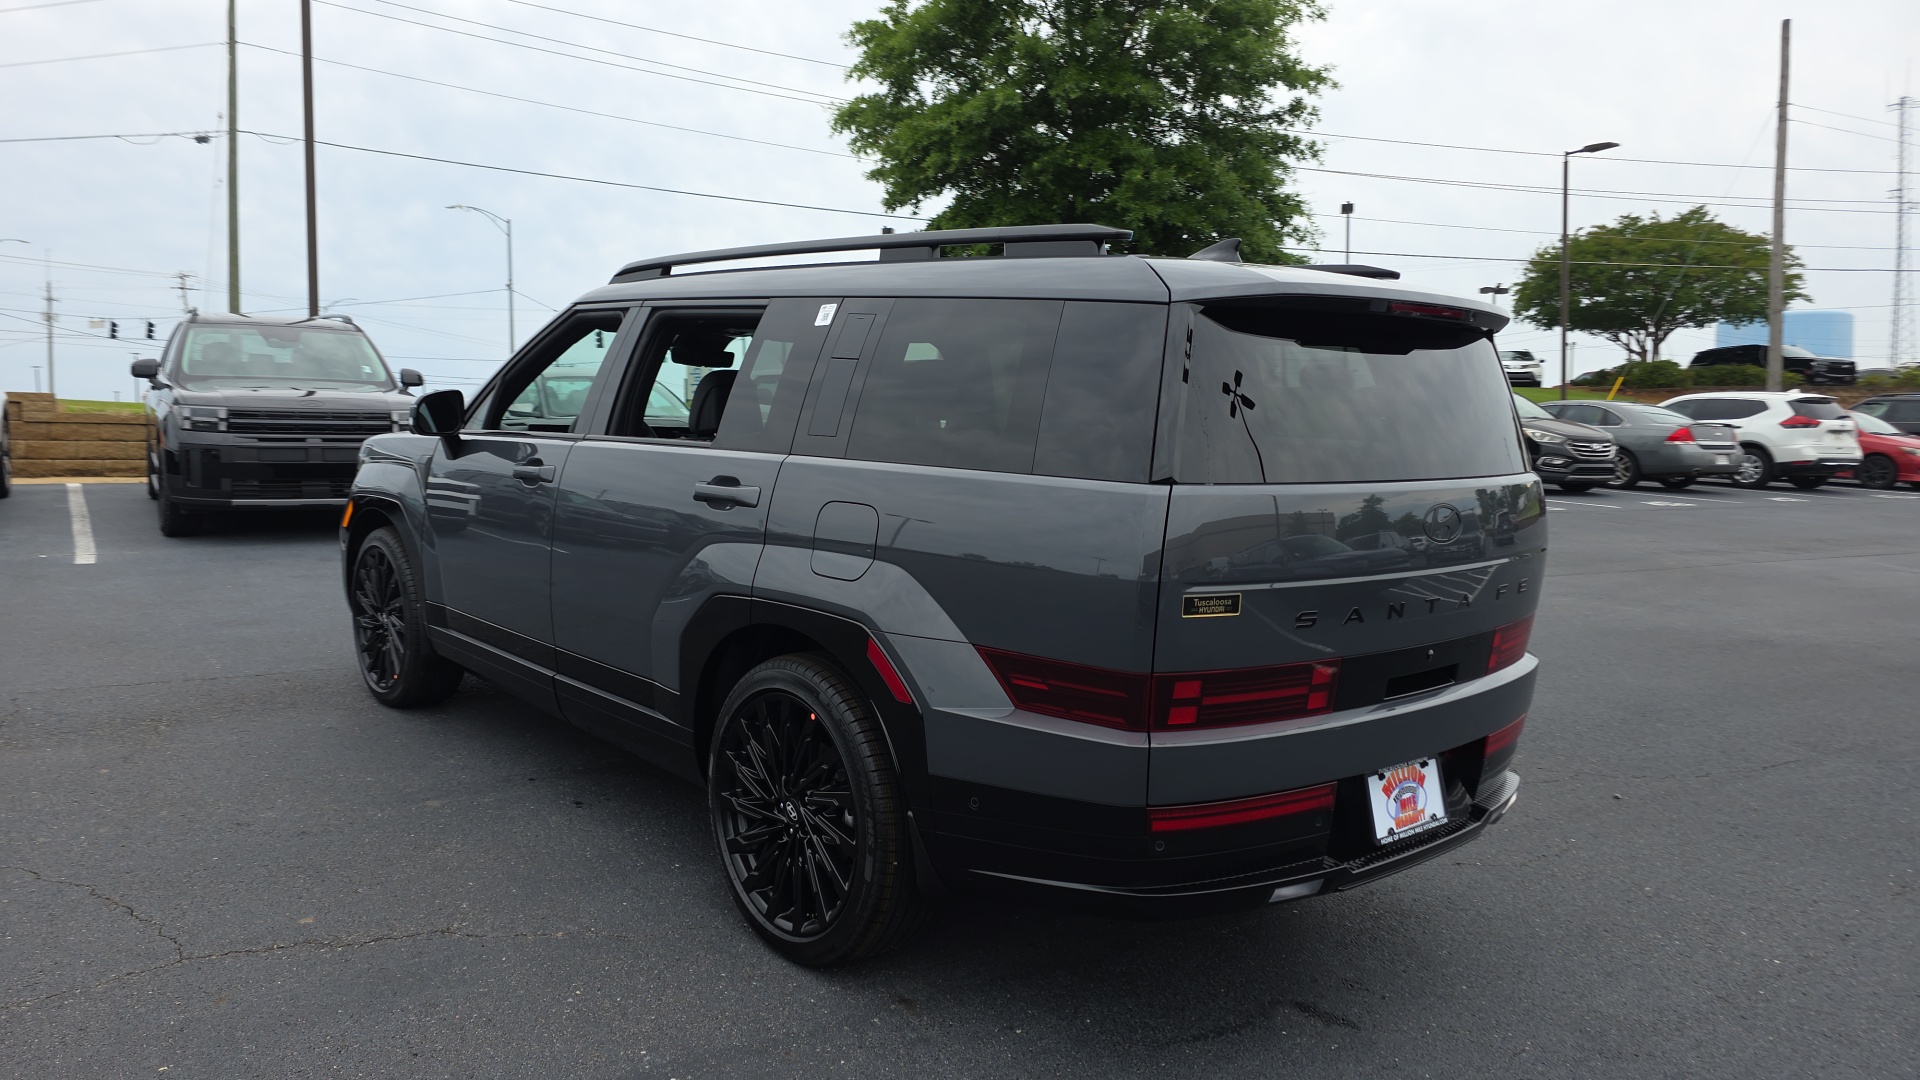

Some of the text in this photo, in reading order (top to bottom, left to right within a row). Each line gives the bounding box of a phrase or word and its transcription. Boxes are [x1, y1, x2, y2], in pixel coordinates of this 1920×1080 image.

[1193, 597, 1232, 606] Tuscaloosa
[1198, 605, 1226, 614] HYUNDAI
[1294, 578, 1529, 629] SANTA FE
[1381, 765, 1426, 800] MILLION
[1400, 794, 1417, 814] MILE
